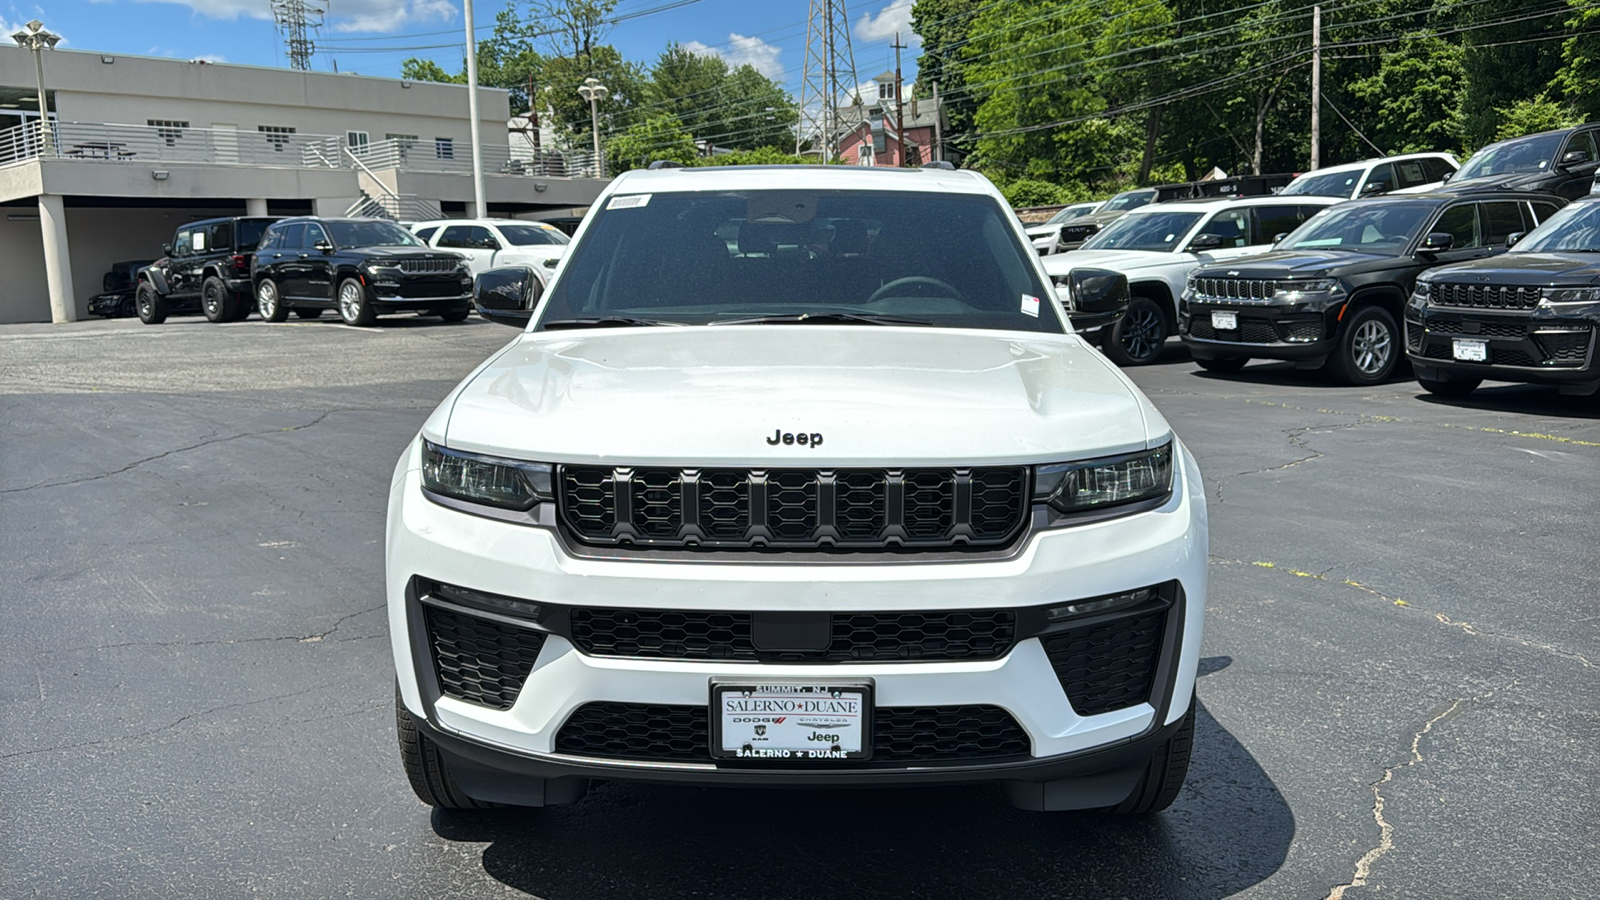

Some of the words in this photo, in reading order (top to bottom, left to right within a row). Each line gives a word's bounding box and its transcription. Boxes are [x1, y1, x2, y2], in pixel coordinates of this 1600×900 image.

[766, 429, 824, 449] Jeep
[726, 700, 796, 712] SALERNO
[804, 701, 858, 713] DUANE
[807, 731, 840, 744] Jeep
[736, 748, 791, 758] SALERNO
[808, 750, 848, 759] DUANE
